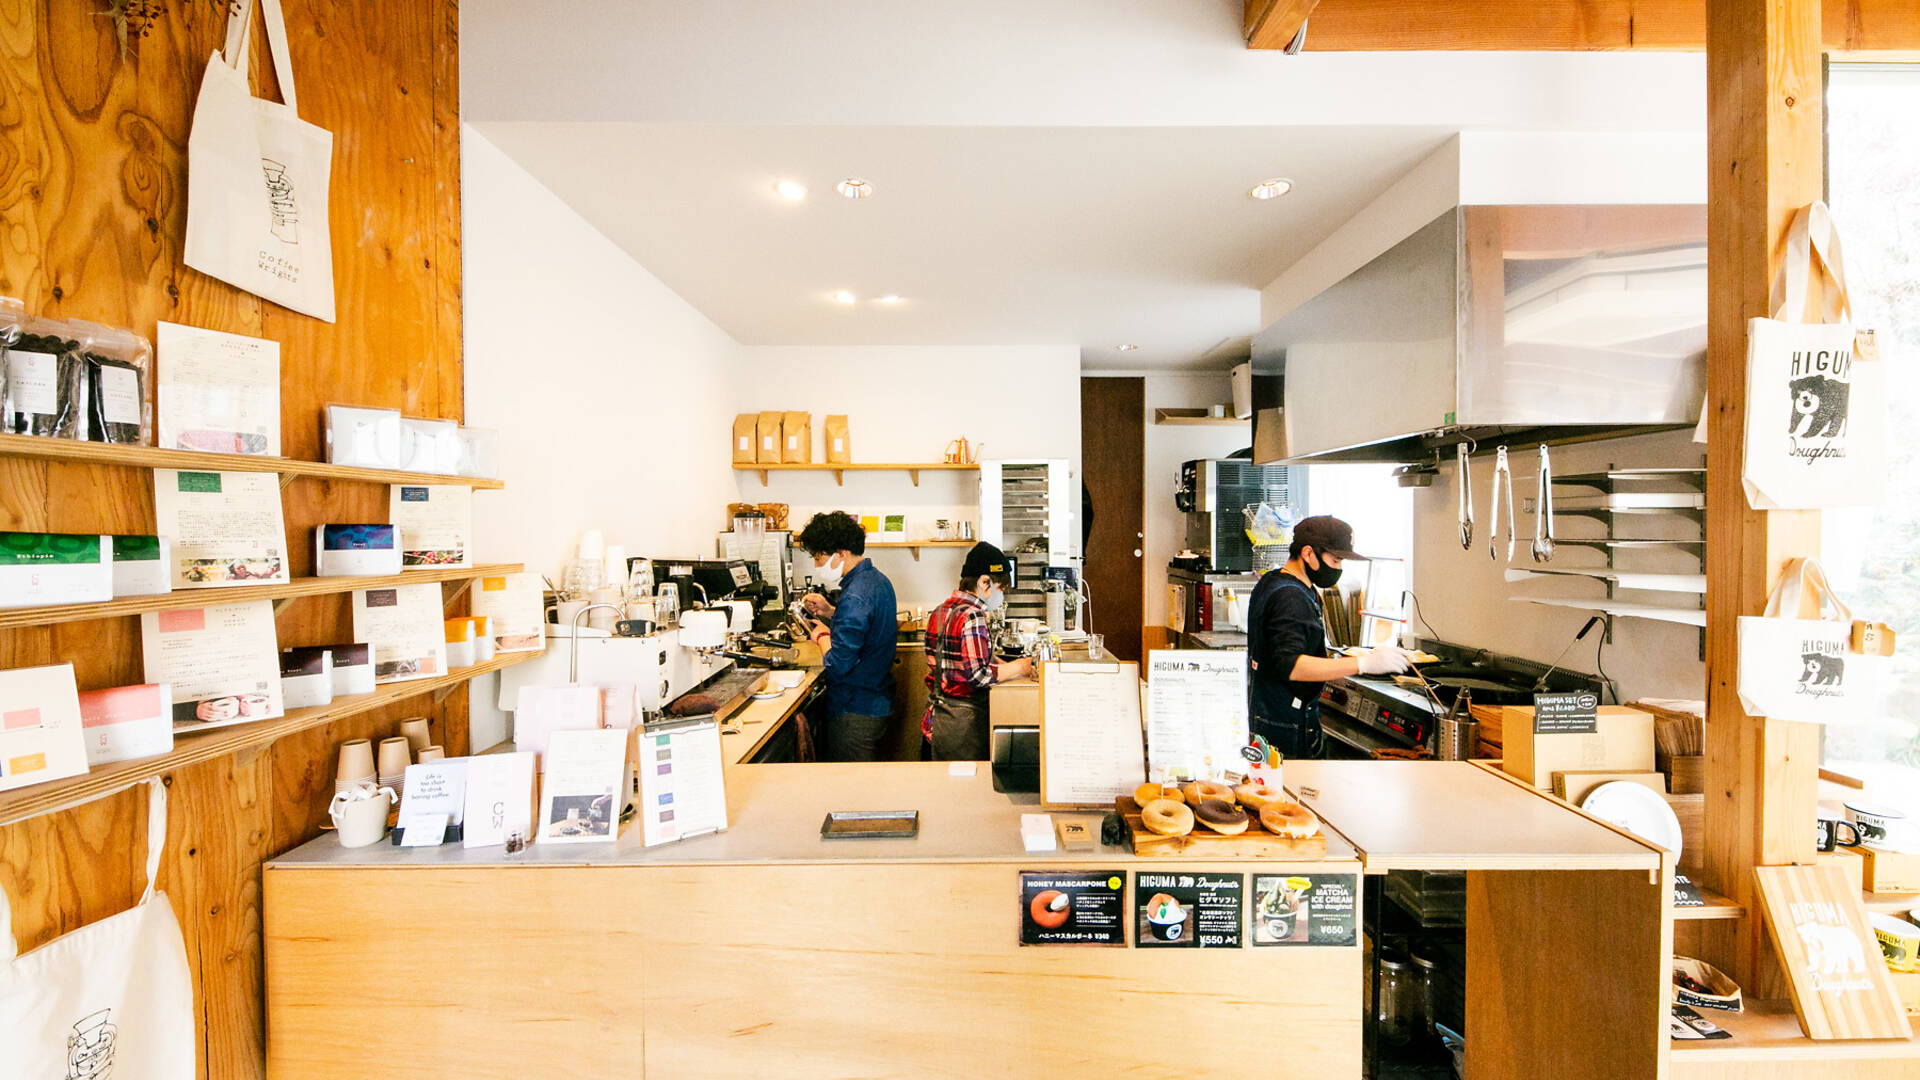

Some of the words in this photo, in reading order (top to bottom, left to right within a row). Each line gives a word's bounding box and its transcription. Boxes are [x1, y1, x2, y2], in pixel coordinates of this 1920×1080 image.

[1790, 350, 1852, 379] HIGUM
[1154, 662, 1185, 671] HIGUMA
[1140, 875, 1176, 888] HIGUMA
[1196, 877, 1239, 891] Doughnuts
[1311, 896, 1324, 904] ICE
[1325, 896, 1353, 904] CREAM
[1320, 925, 1344, 935] ¥650
[1199, 935, 1223, 945] ¥550
